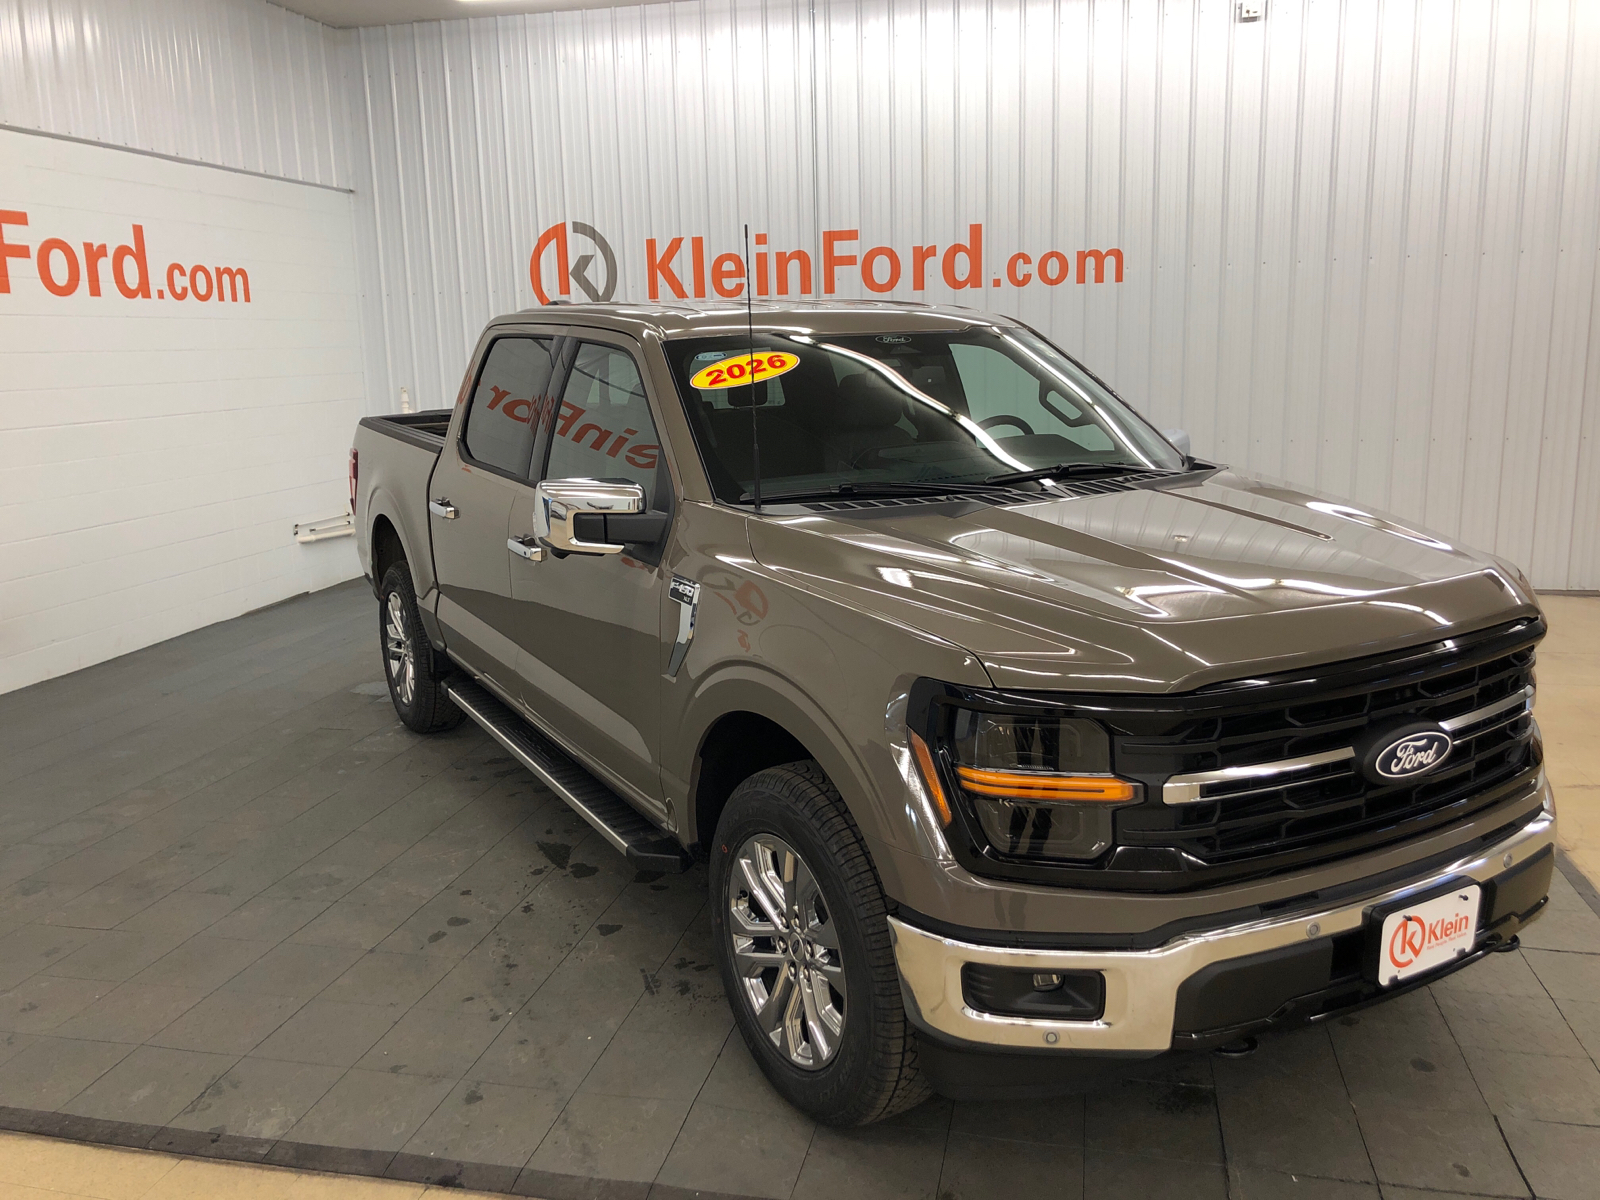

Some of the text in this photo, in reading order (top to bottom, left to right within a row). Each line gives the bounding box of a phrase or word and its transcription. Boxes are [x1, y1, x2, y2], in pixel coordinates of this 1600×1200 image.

[645, 223, 1125, 301] KleinFord.com
[705, 354, 788, 387] 2026
[1390, 738, 1439, 773] Ford
[1427, 912, 1469, 944] Klein
